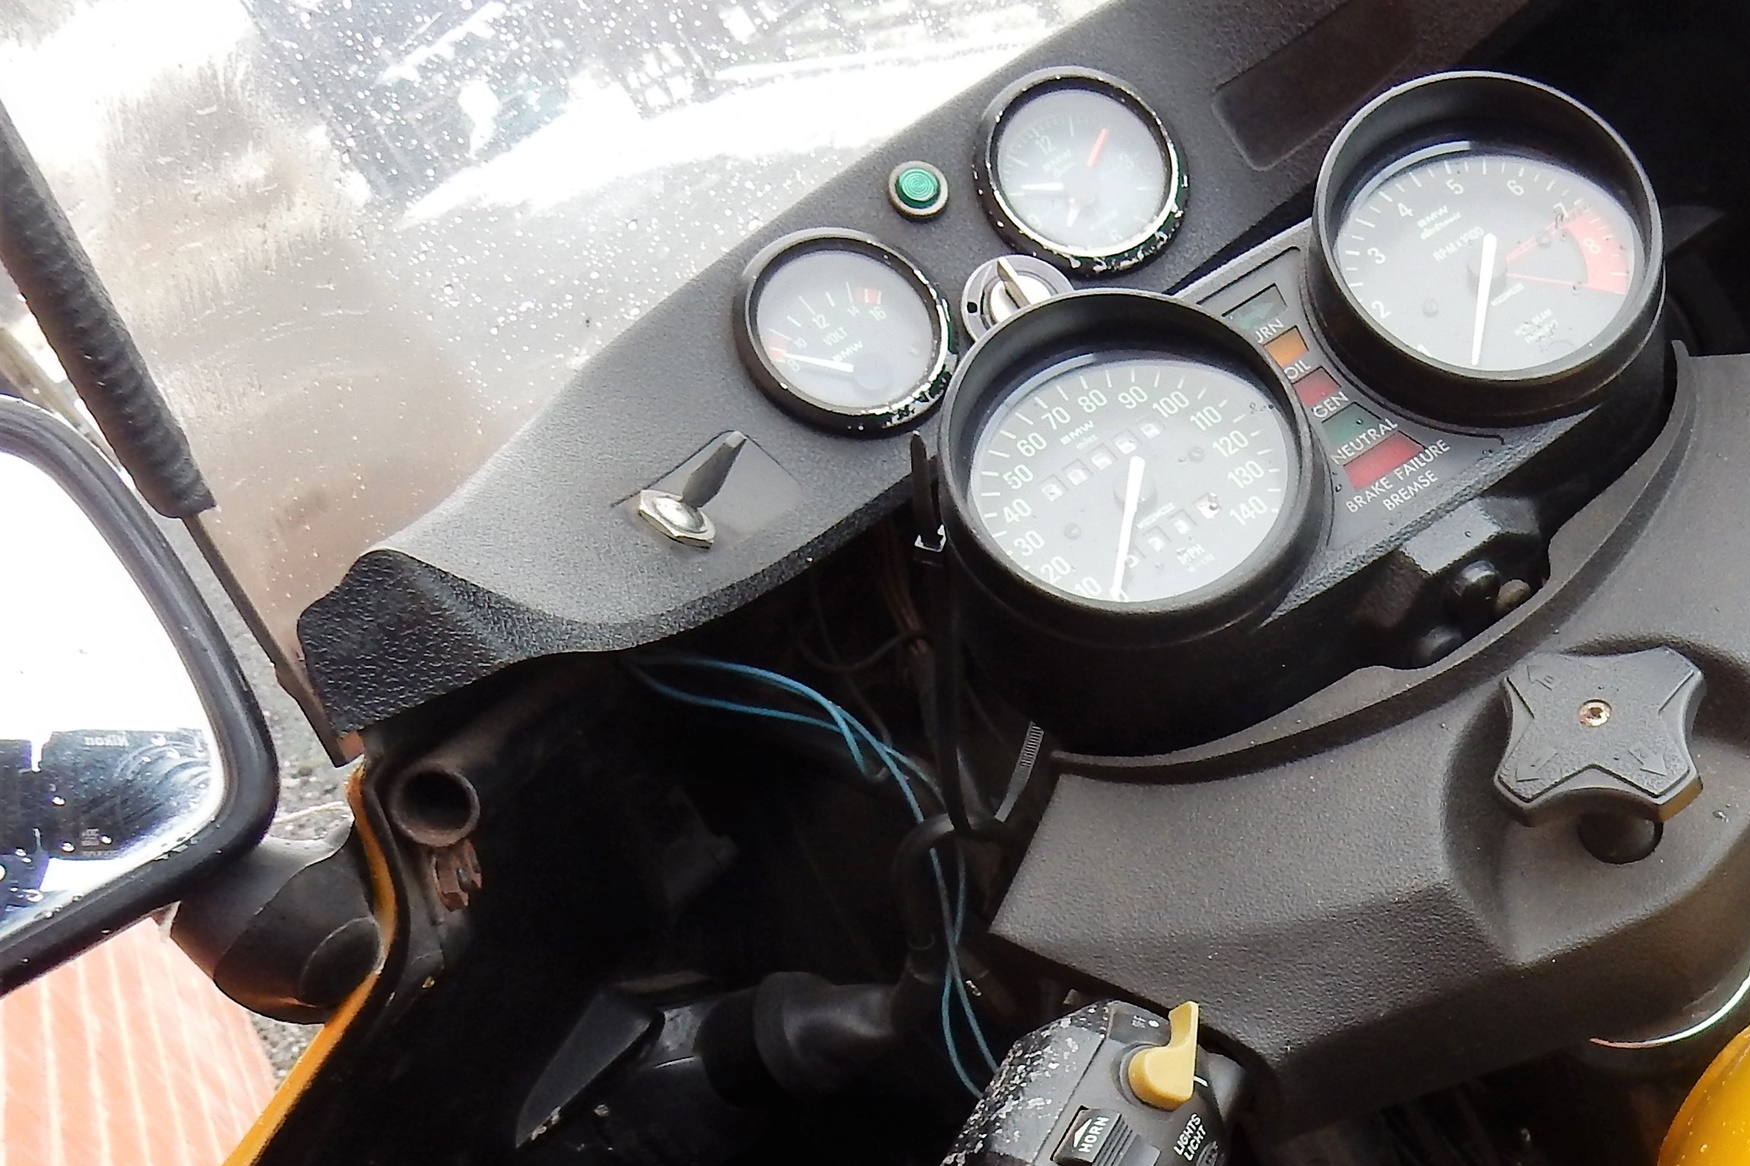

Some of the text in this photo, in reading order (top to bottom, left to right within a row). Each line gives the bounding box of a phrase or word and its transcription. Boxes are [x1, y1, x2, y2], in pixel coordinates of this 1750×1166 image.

[1035, 135, 1057, 153] 12
[1446, 179, 1465, 195] 5
[1506, 180, 1525, 196] 6
[1396, 202, 1414, 219] 4
[1367, 247, 1387, 265] 3
[1584, 239, 1602, 255] 8
[811, 313, 830, 331] 12
[869, 305, 888, 322] 16
[1371, 300, 1392, 319] 2
[822, 325, 850, 347] VOLT
[1283, 359, 1311, 380] OIL
[1076, 388, 1109, 414] 80
[1117, 385, 1149, 410] 90
[1151, 390, 1190, 419] 100
[1312, 391, 1349, 419] GEN
[1041, 405, 1072, 431] 70
[1189, 405, 1223, 431] 110
[1016, 431, 1048, 458] 60
[1059, 419, 1095, 444] BMW
[1211, 429, 1250, 459] 120
[1330, 417, 1398, 465] NEUTRAL
[1002, 464, 1034, 490] 50
[1227, 460, 1265, 490] 130
[1345, 438, 1450, 514] BRAKE FAILURE
[1382, 469, 1438, 511] BREMSE
[1002, 498, 1033, 526] 40
[1229, 495, 1269, 527] 140
[1013, 529, 1045, 557] 30
[1040, 554, 1072, 585] 20
[1073, 576, 1103, 600] 10
[1078, 1115, 1110, 1154] HORN
[1173, 1112, 1202, 1156] LIGHTS
[1183, 1125, 1207, 1162] LICHT
